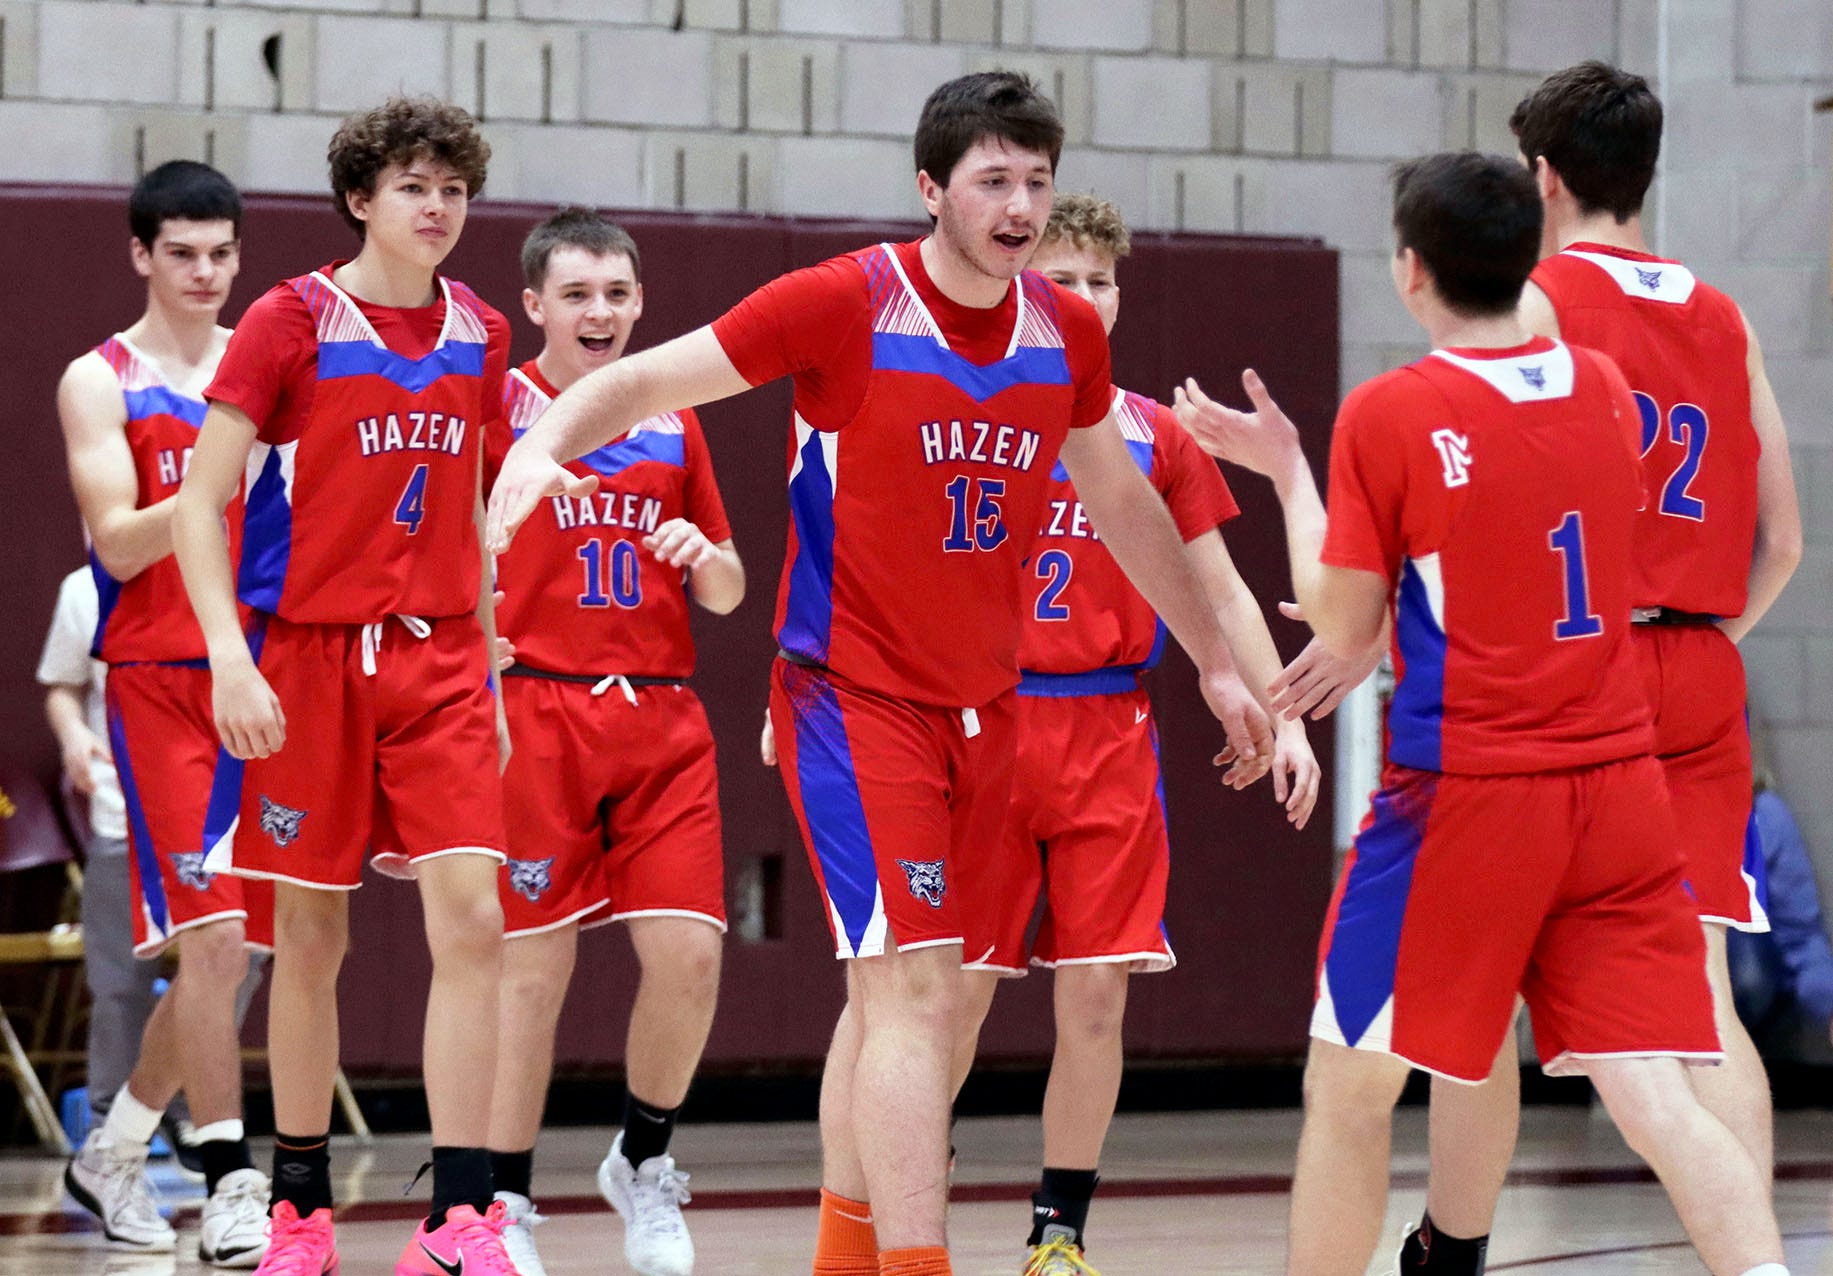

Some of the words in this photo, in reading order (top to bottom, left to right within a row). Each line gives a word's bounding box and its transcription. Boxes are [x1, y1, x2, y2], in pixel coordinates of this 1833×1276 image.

[357, 412, 466, 456] HAZEN
[920, 421, 1040, 471] HAZEN
[392, 464, 429, 535] 4
[552, 491, 662, 533] HAZEN
[943, 474, 1009, 552] 15
[1038, 500, 1100, 541] ZE
[576, 537, 643, 610] 10
[1034, 548, 1073, 622] 2
[1548, 511, 1603, 641] 1
